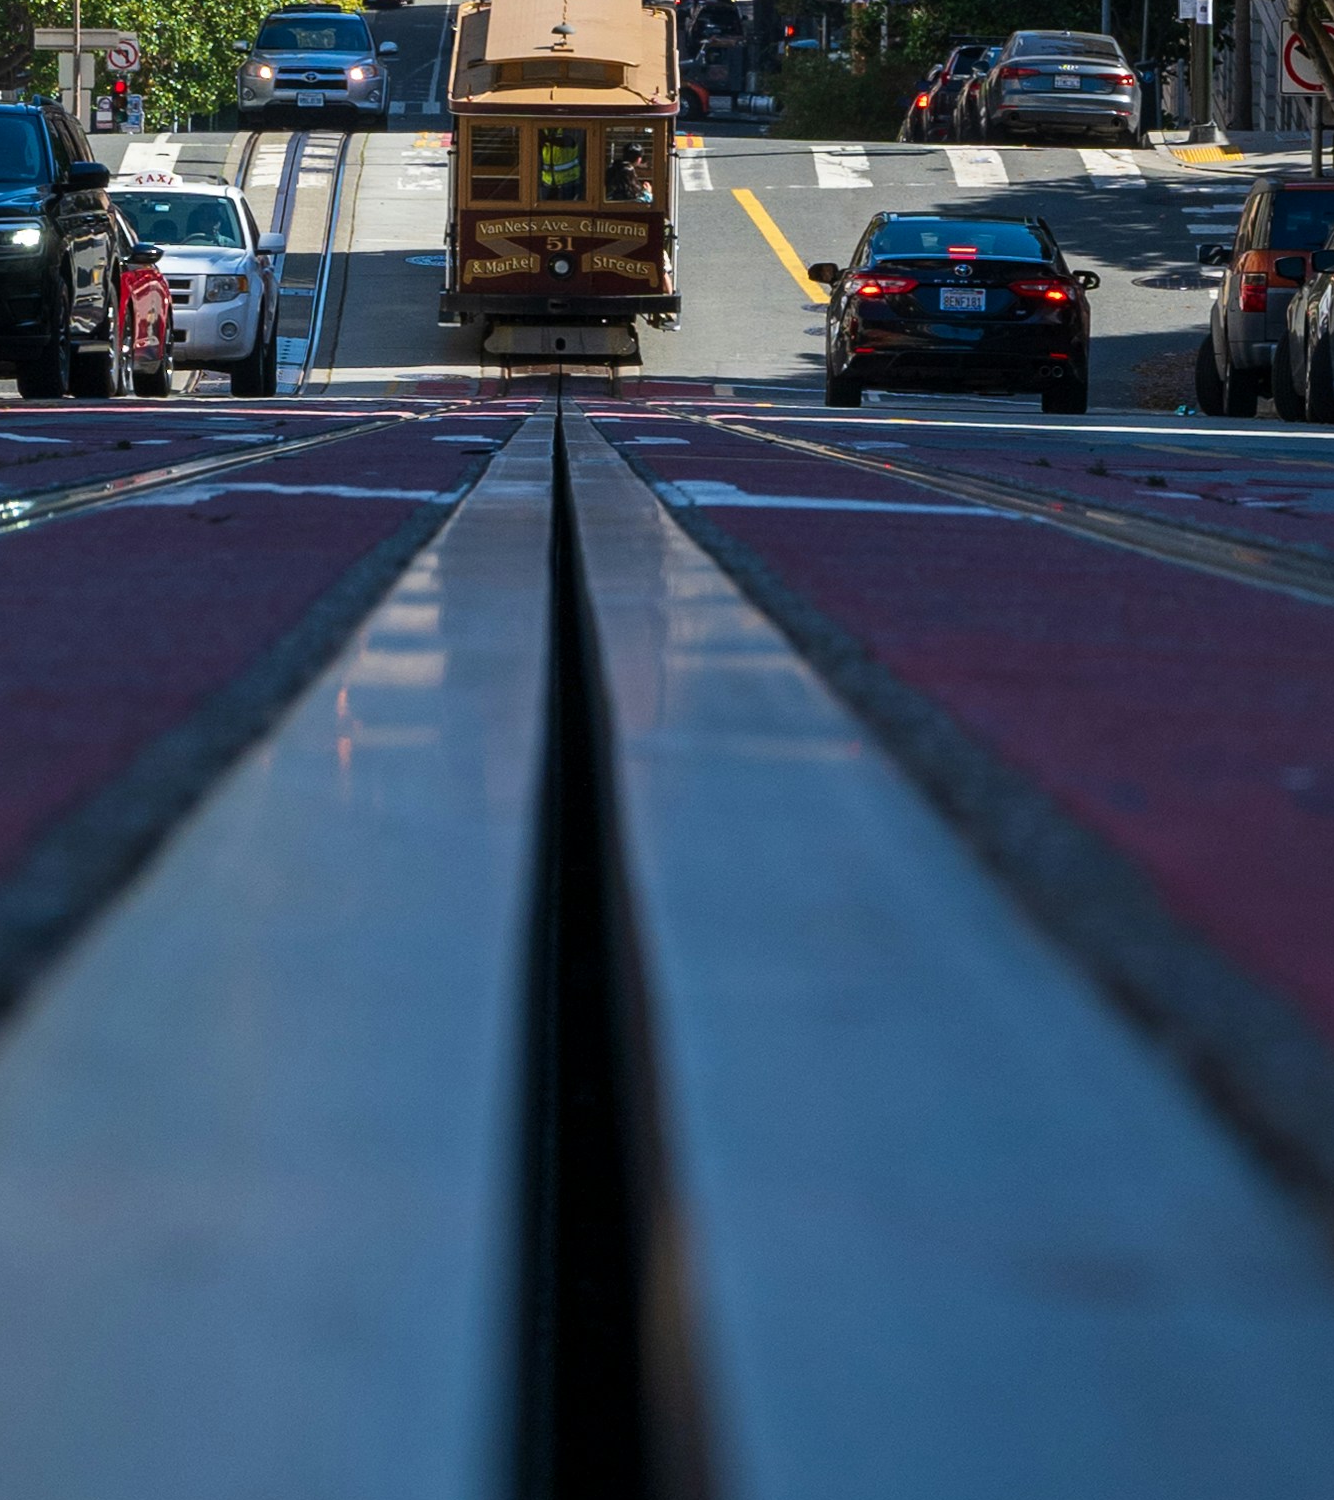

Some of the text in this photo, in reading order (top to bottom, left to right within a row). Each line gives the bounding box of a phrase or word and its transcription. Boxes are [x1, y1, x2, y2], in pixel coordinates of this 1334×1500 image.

[135, 174, 174, 185] TAXI
[479, 223, 504, 235] Van
[504, 220, 537, 232] Ness
[579, 220, 647, 237] California
[546, 236, 576, 251] 51
[472, 256, 651, 275] & Market Streets
